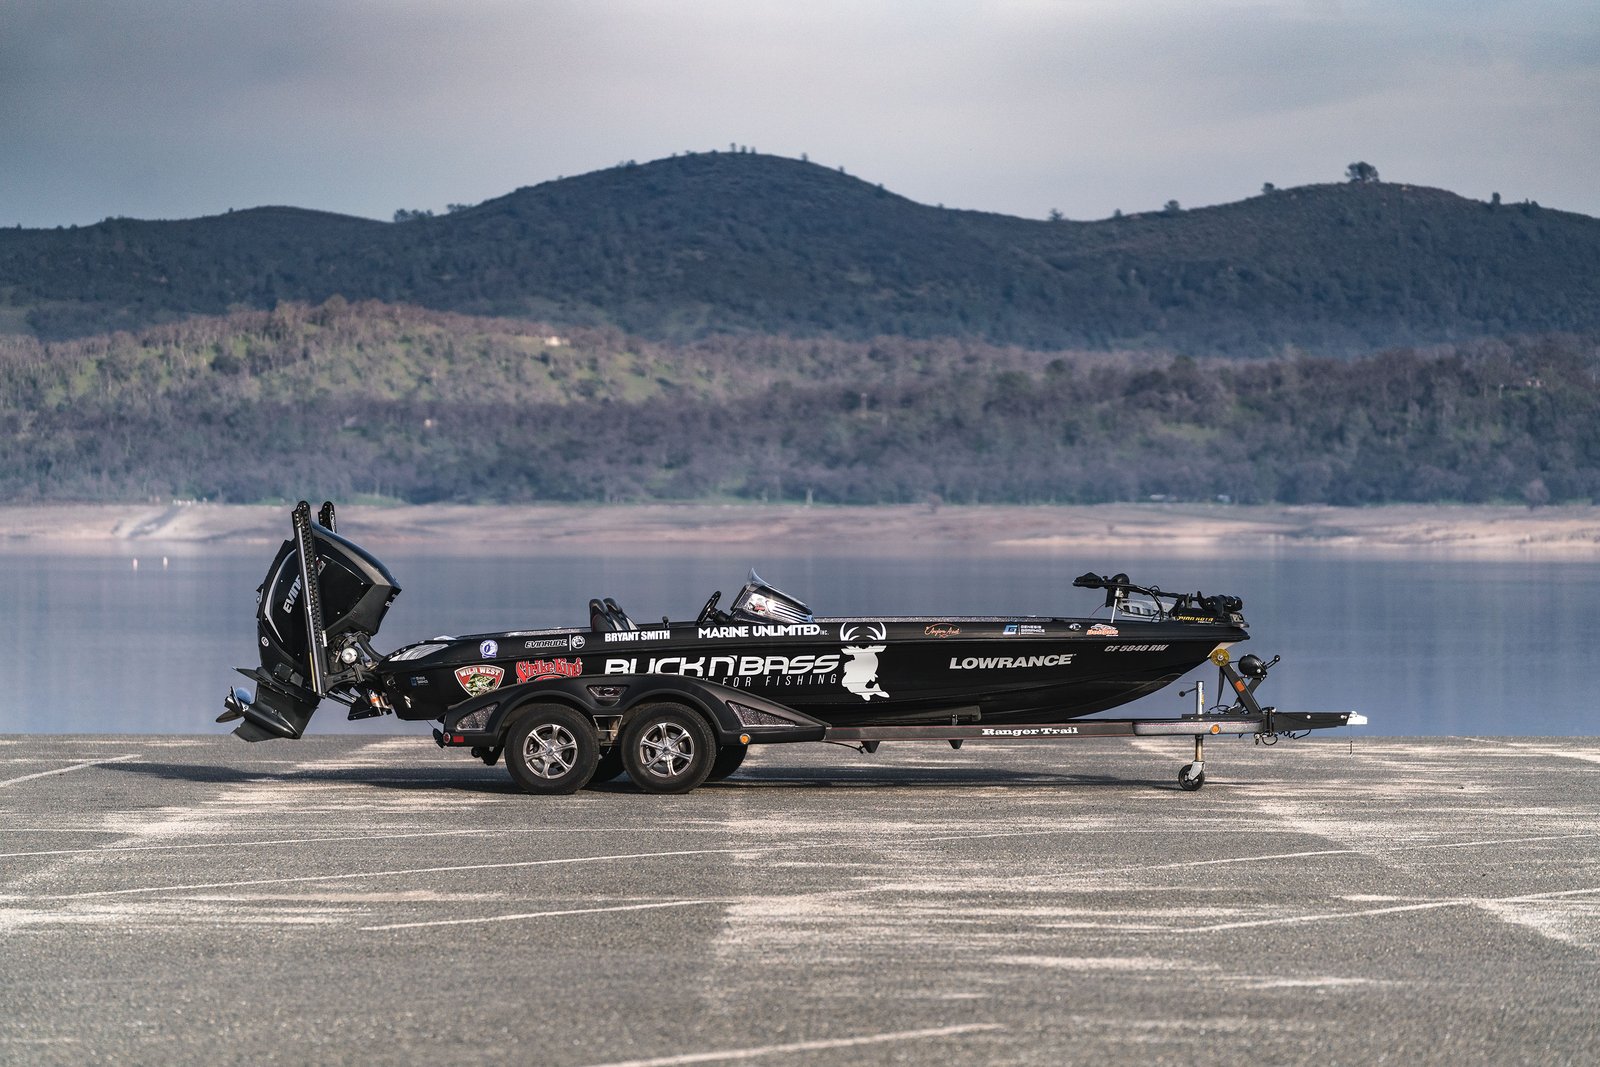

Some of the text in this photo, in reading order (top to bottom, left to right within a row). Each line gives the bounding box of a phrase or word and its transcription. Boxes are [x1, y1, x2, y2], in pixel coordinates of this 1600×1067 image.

[604, 630, 670, 642] BRYANT SMITH
[698, 626, 749, 639] MARINE
[752, 624, 820, 637] UNLIMITED
[949, 653, 1074, 670] LOWRANCE
[459, 667, 501, 678] WILD WEST
[516, 657, 583, 684] Strike King
[722, 673, 837, 688] FOR FISHING
[981, 726, 1079, 737] Ranger Trail
